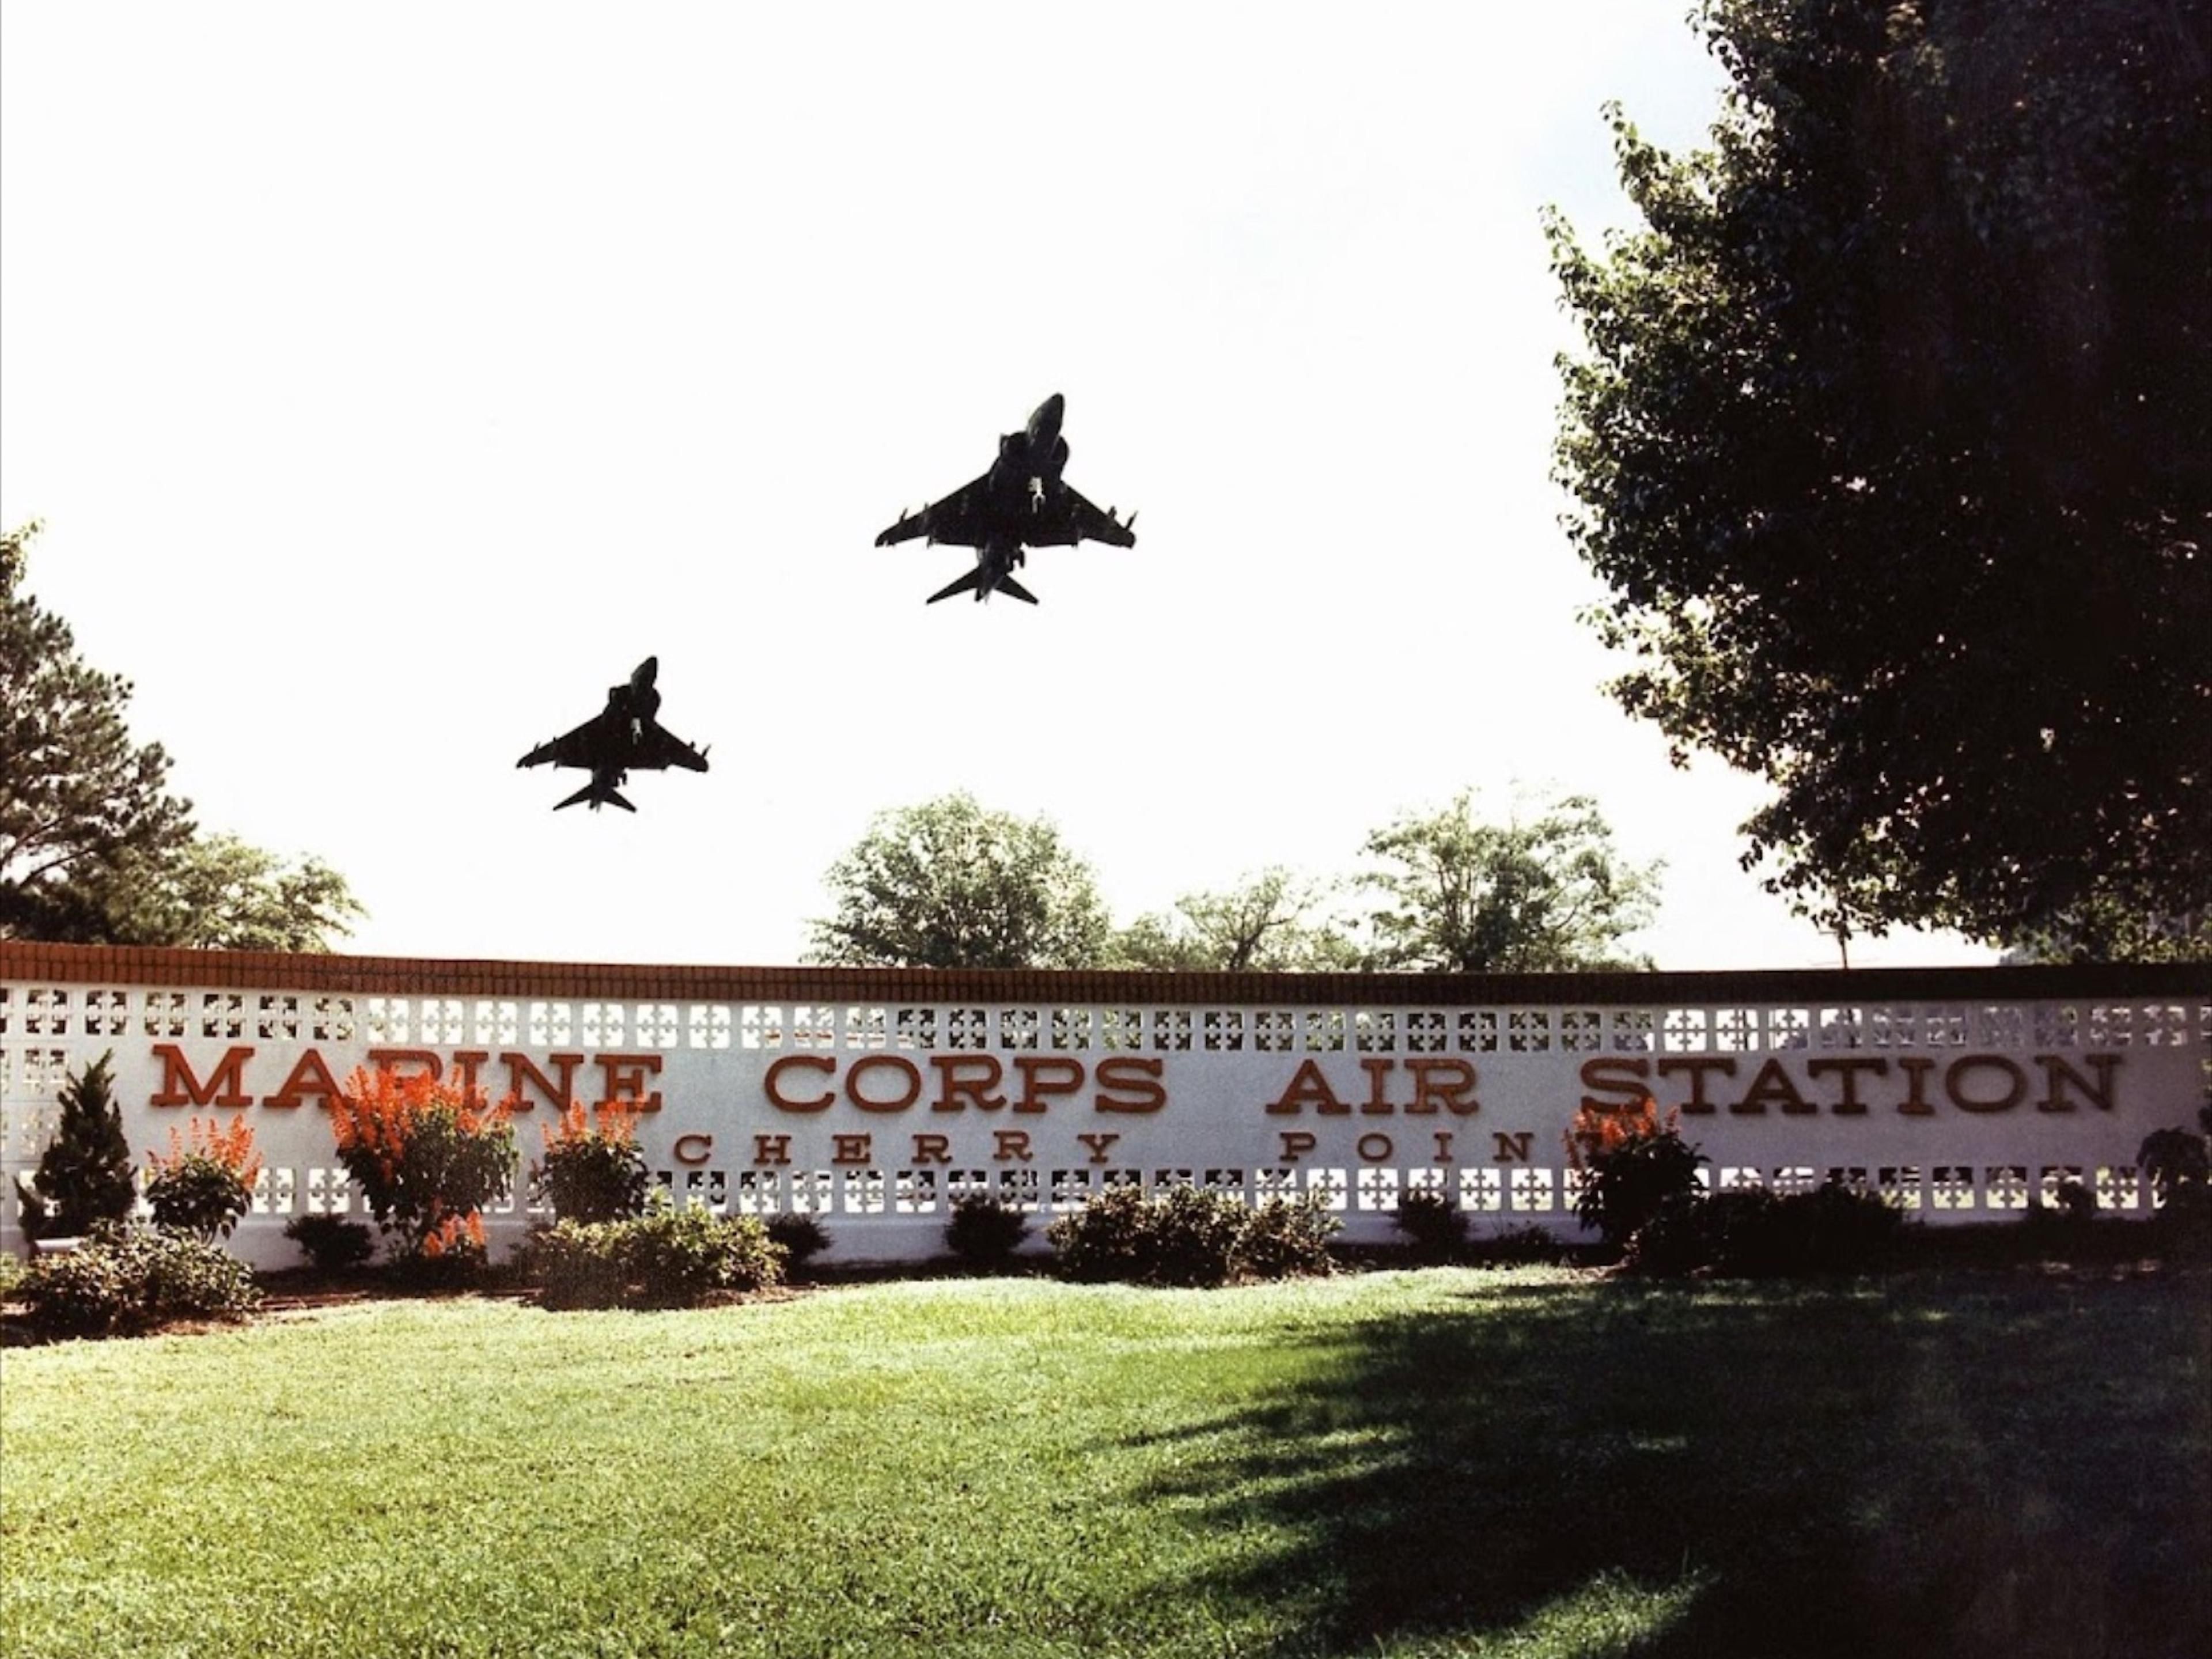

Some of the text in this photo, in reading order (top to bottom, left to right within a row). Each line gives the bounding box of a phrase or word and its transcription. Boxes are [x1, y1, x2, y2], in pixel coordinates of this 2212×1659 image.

[765, 1055, 1167, 1113] CORPS
[1266, 1058, 1479, 1115] AIR
[1580, 1055, 2122, 1115] STATION
[674, 1131, 1120, 1164] CHERRY
